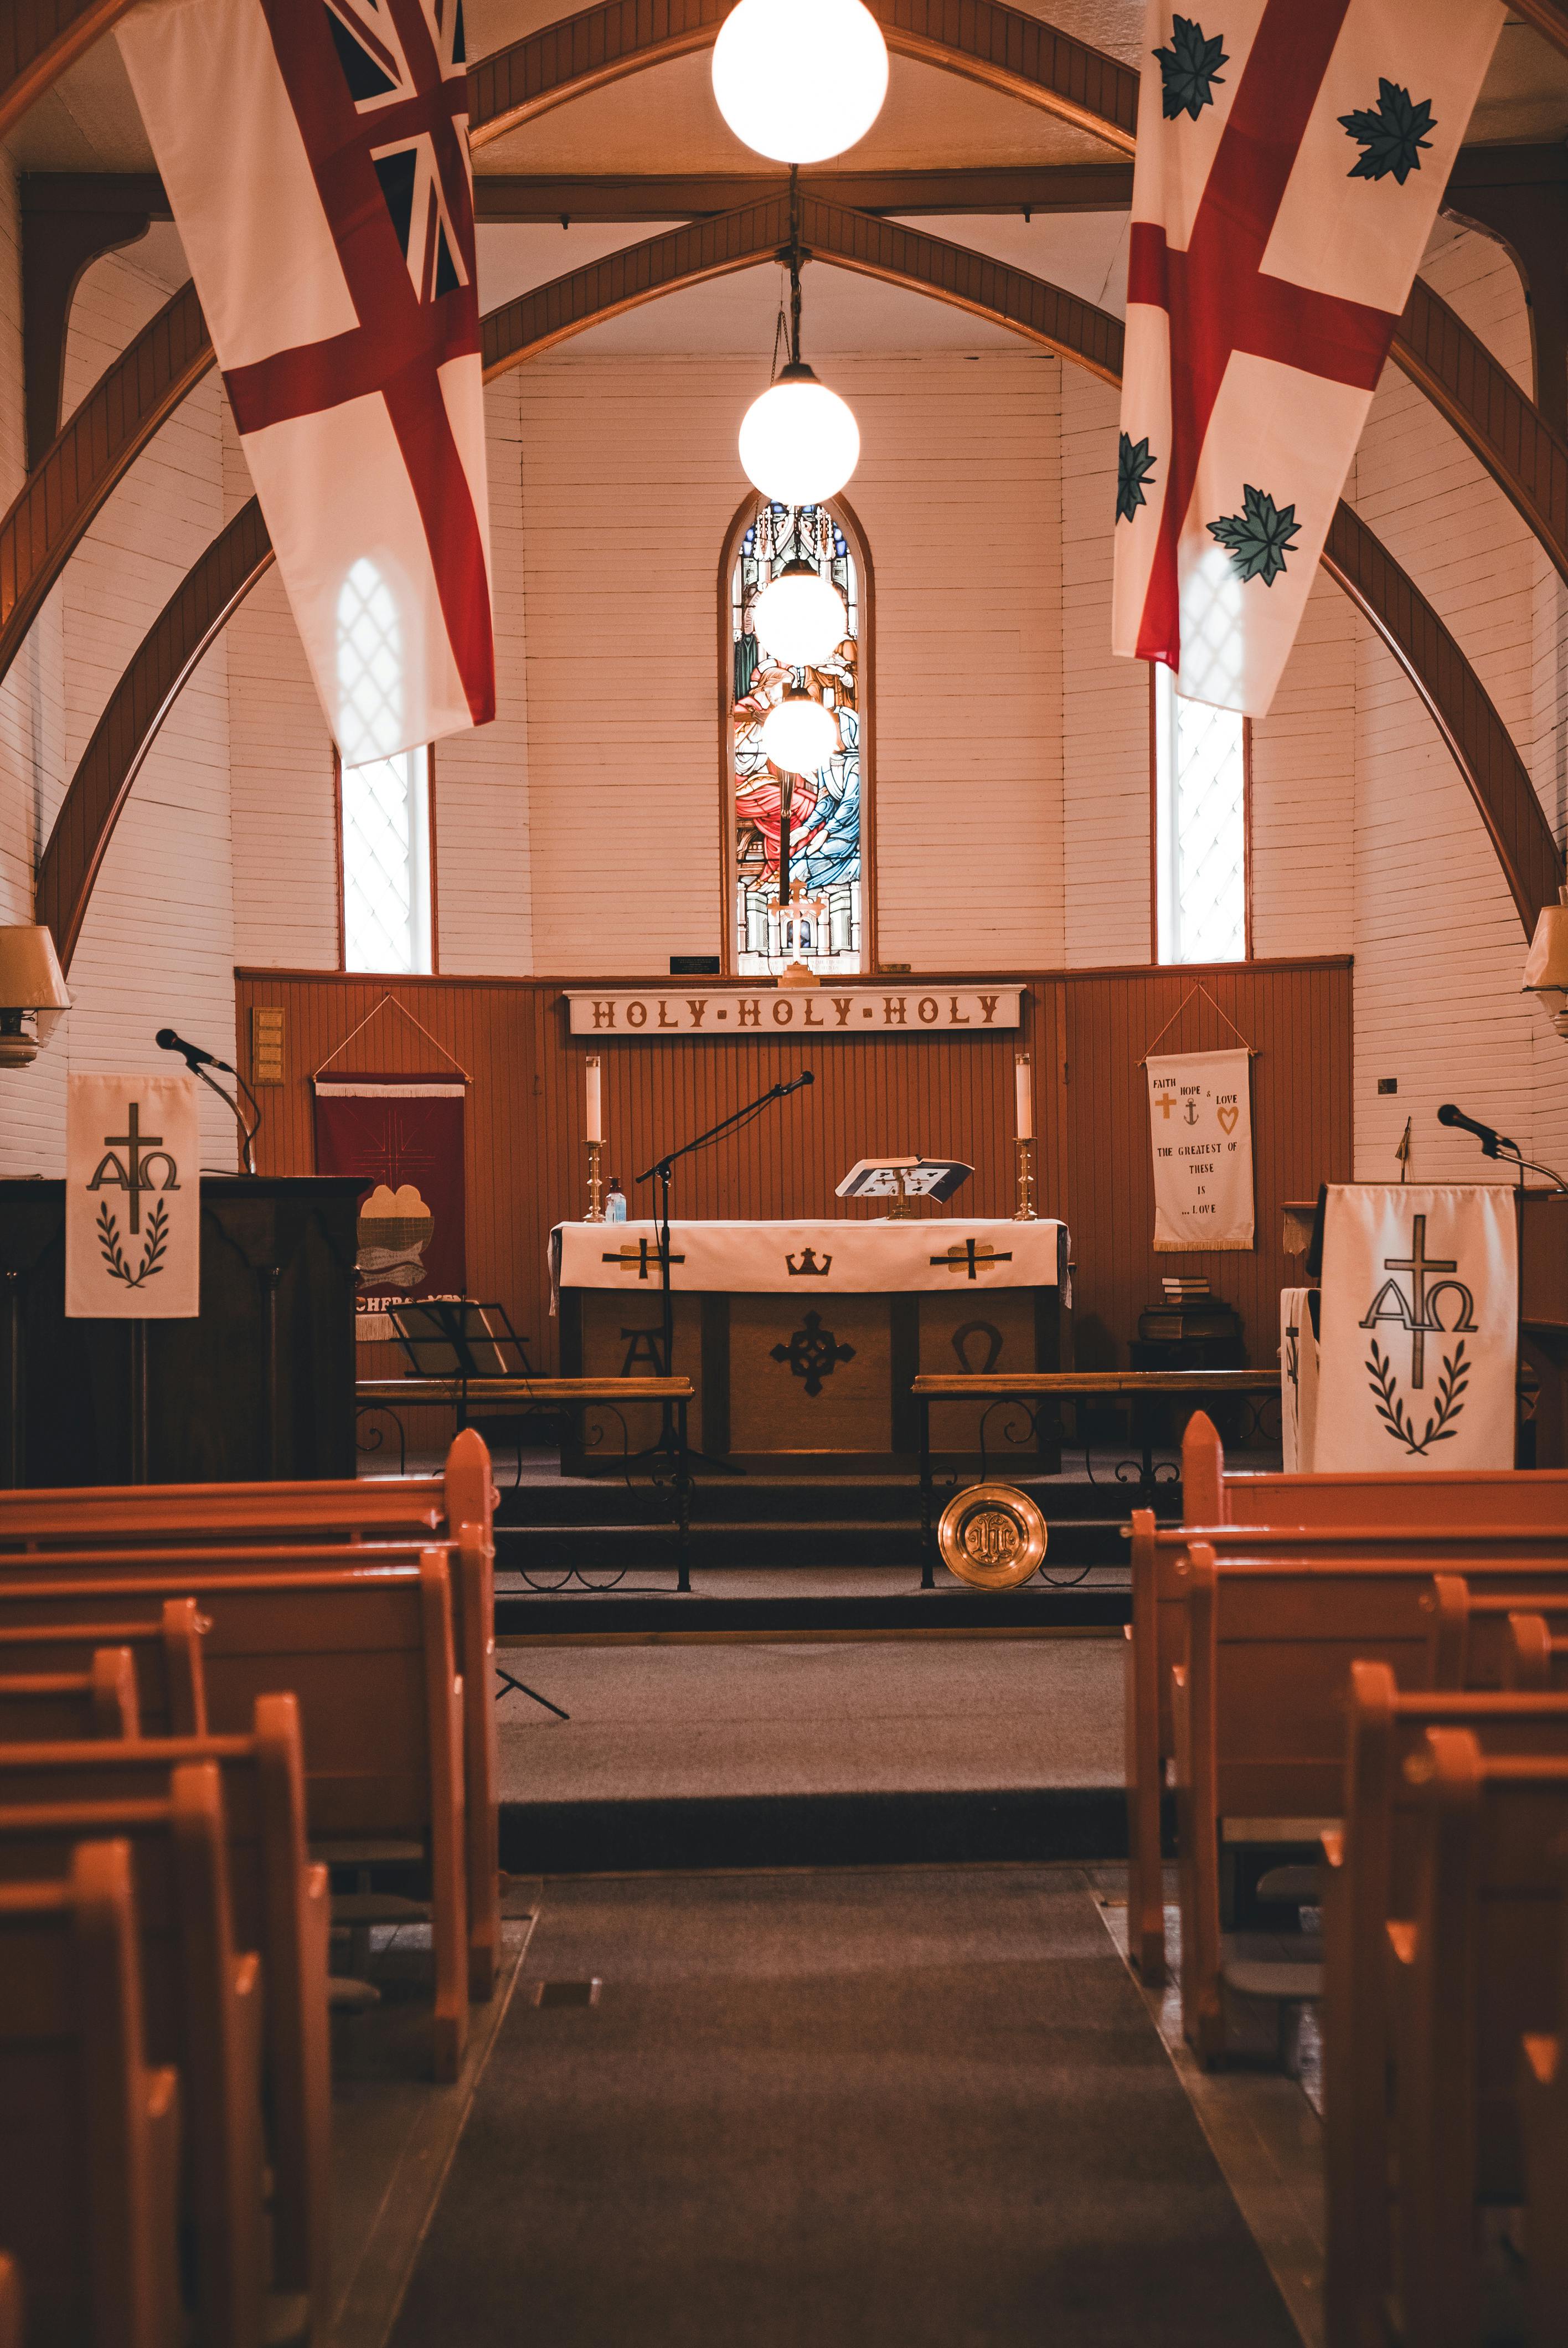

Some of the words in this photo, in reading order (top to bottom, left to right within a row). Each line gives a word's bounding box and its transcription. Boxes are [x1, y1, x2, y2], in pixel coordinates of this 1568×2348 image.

[591, 1000, 706, 1028] HOLY
[737, 997, 854, 1027] HOLY
[883, 995, 1000, 1024] HOLY
[1153, 1078, 1177, 1089] FAITH
[1180, 1086, 1201, 1096] HOPE
[1216, 1094, 1238, 1105] LOVE
[1157, 1147, 1173, 1157] THE
[1178, 1144, 1222, 1156] GREATEST
[1227, 1142, 1238, 1152] OF
[1189, 1163, 1214, 1174] THESE
[1198, 1186, 1206, 1195] IS
